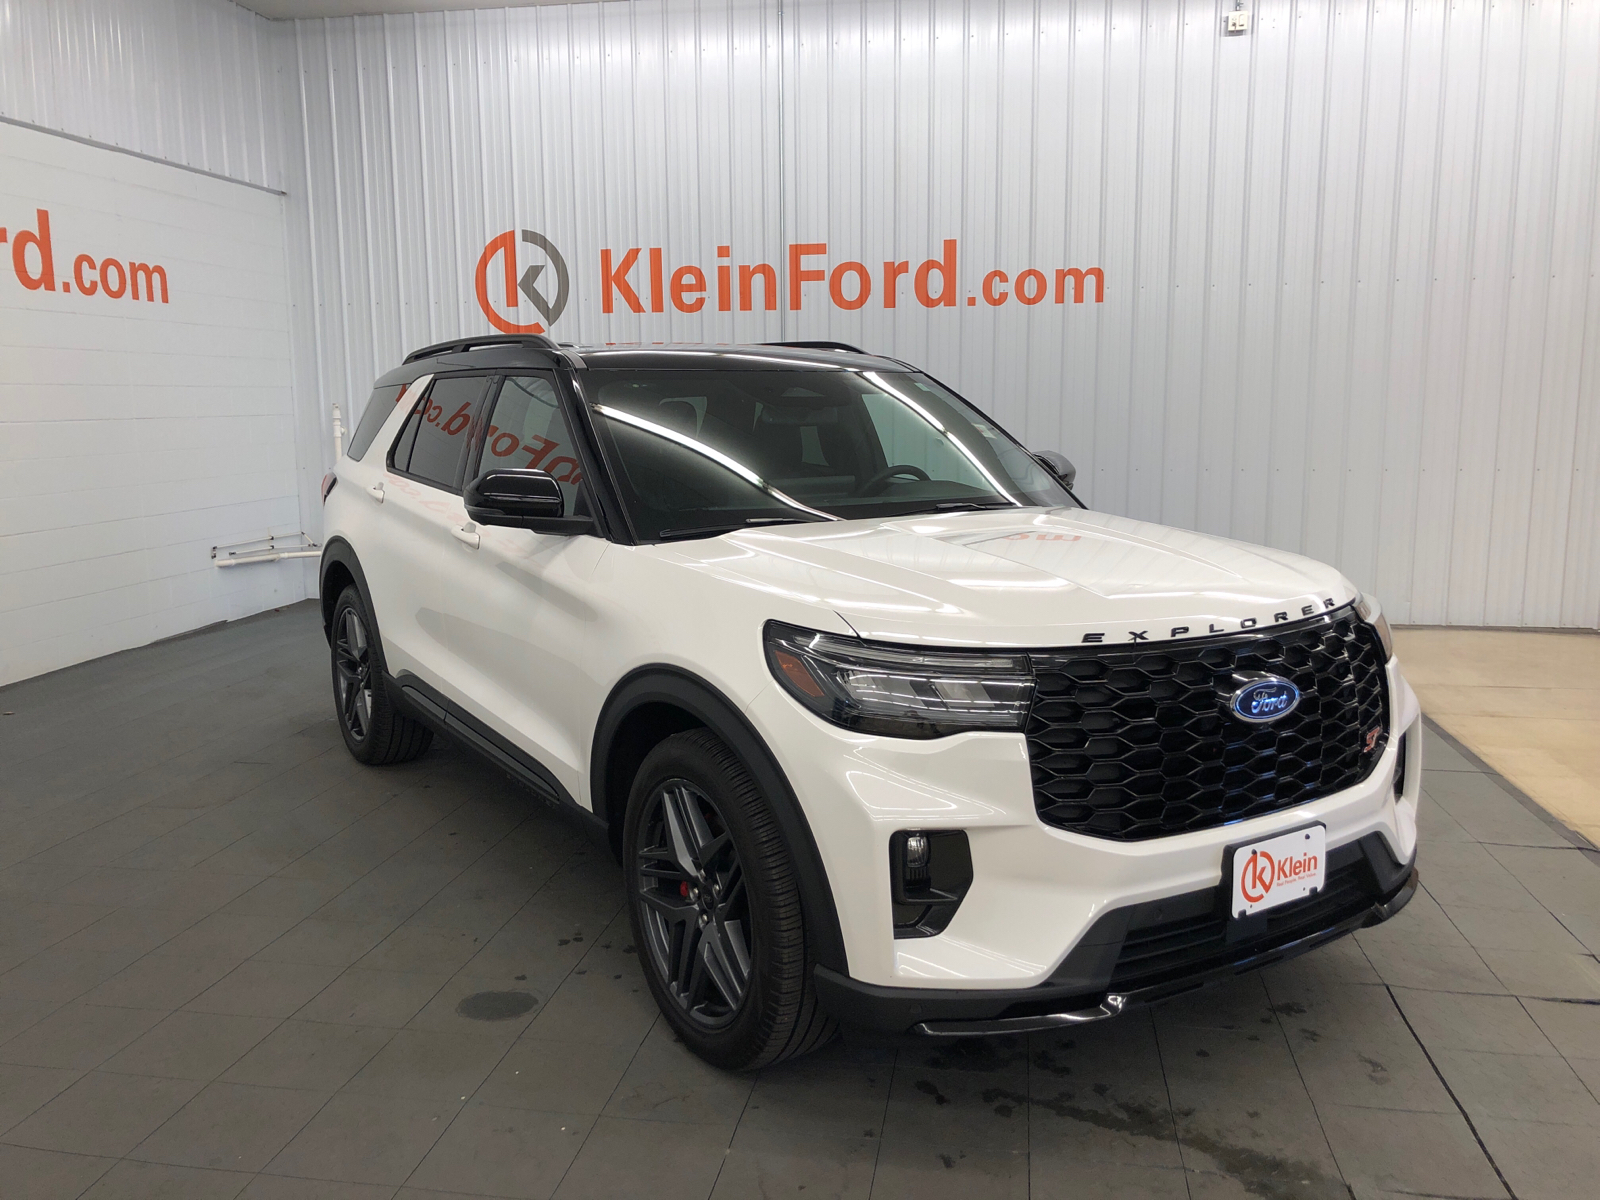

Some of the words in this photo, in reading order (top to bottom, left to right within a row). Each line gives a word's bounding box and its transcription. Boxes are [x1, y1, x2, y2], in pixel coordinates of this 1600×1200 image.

[600, 239, 1105, 314] KleinFord.com
[1081, 597, 1336, 644] EXPLORER
[1251, 686, 1288, 714] Ford
[1277, 852, 1317, 881] Klein
